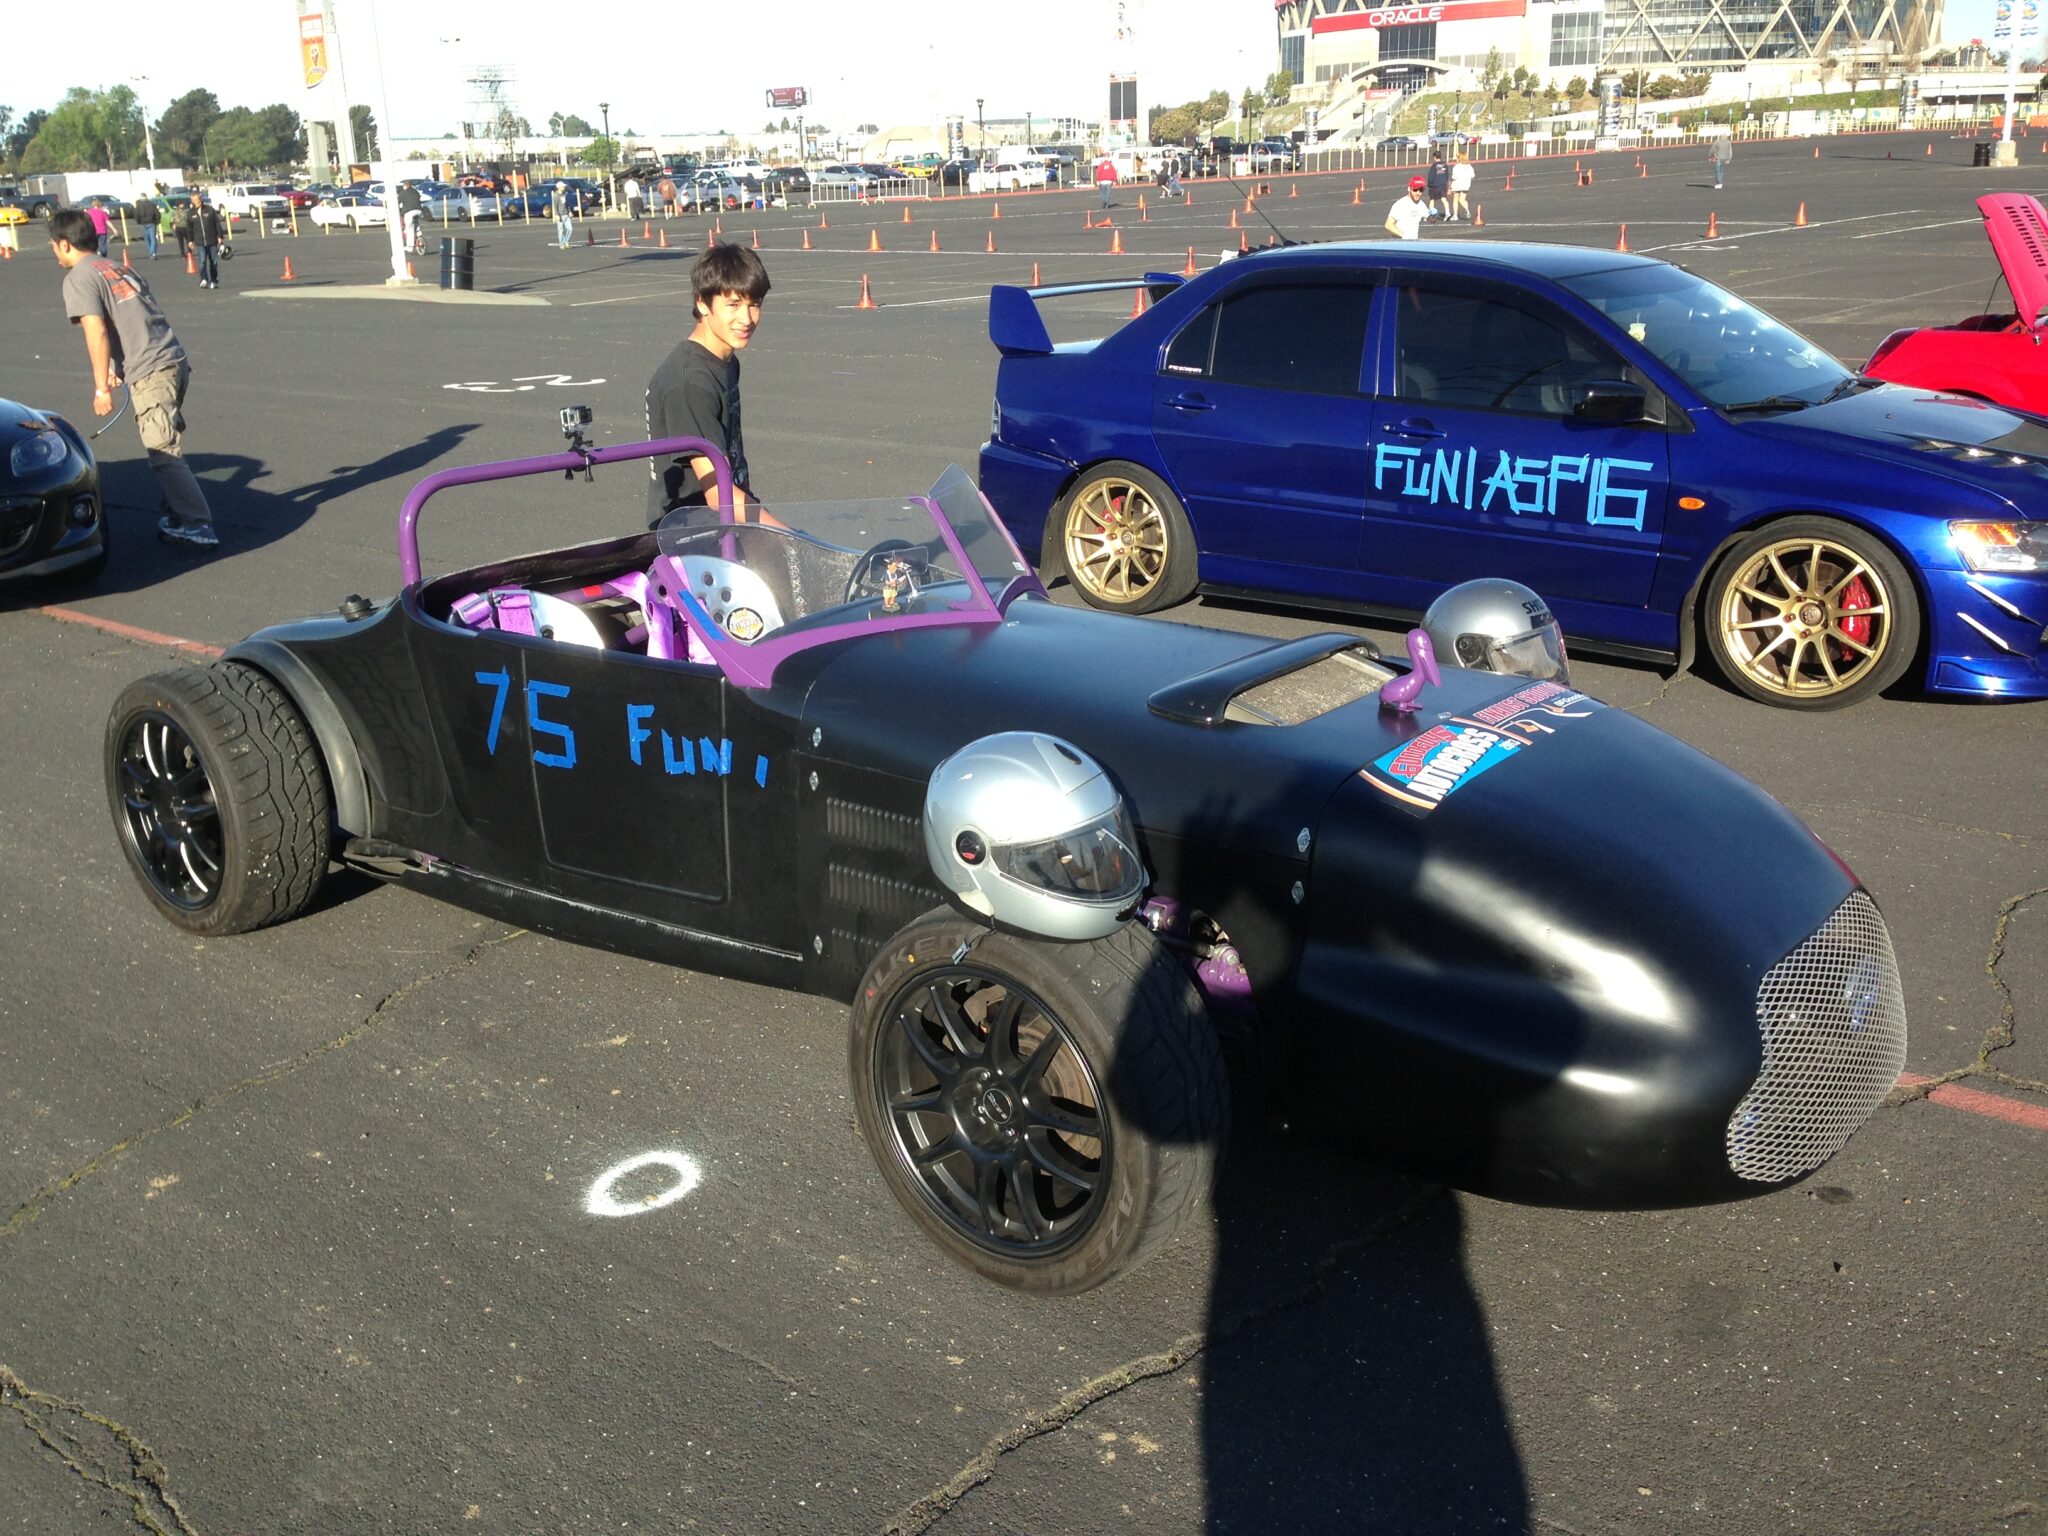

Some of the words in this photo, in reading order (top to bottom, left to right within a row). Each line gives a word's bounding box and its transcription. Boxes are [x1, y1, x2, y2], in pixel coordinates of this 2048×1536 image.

[1369, 7, 1442, 26] ORACLE
[475, 669, 577, 769] 75
[1406, 728, 1500, 801] AUTOCROSS
